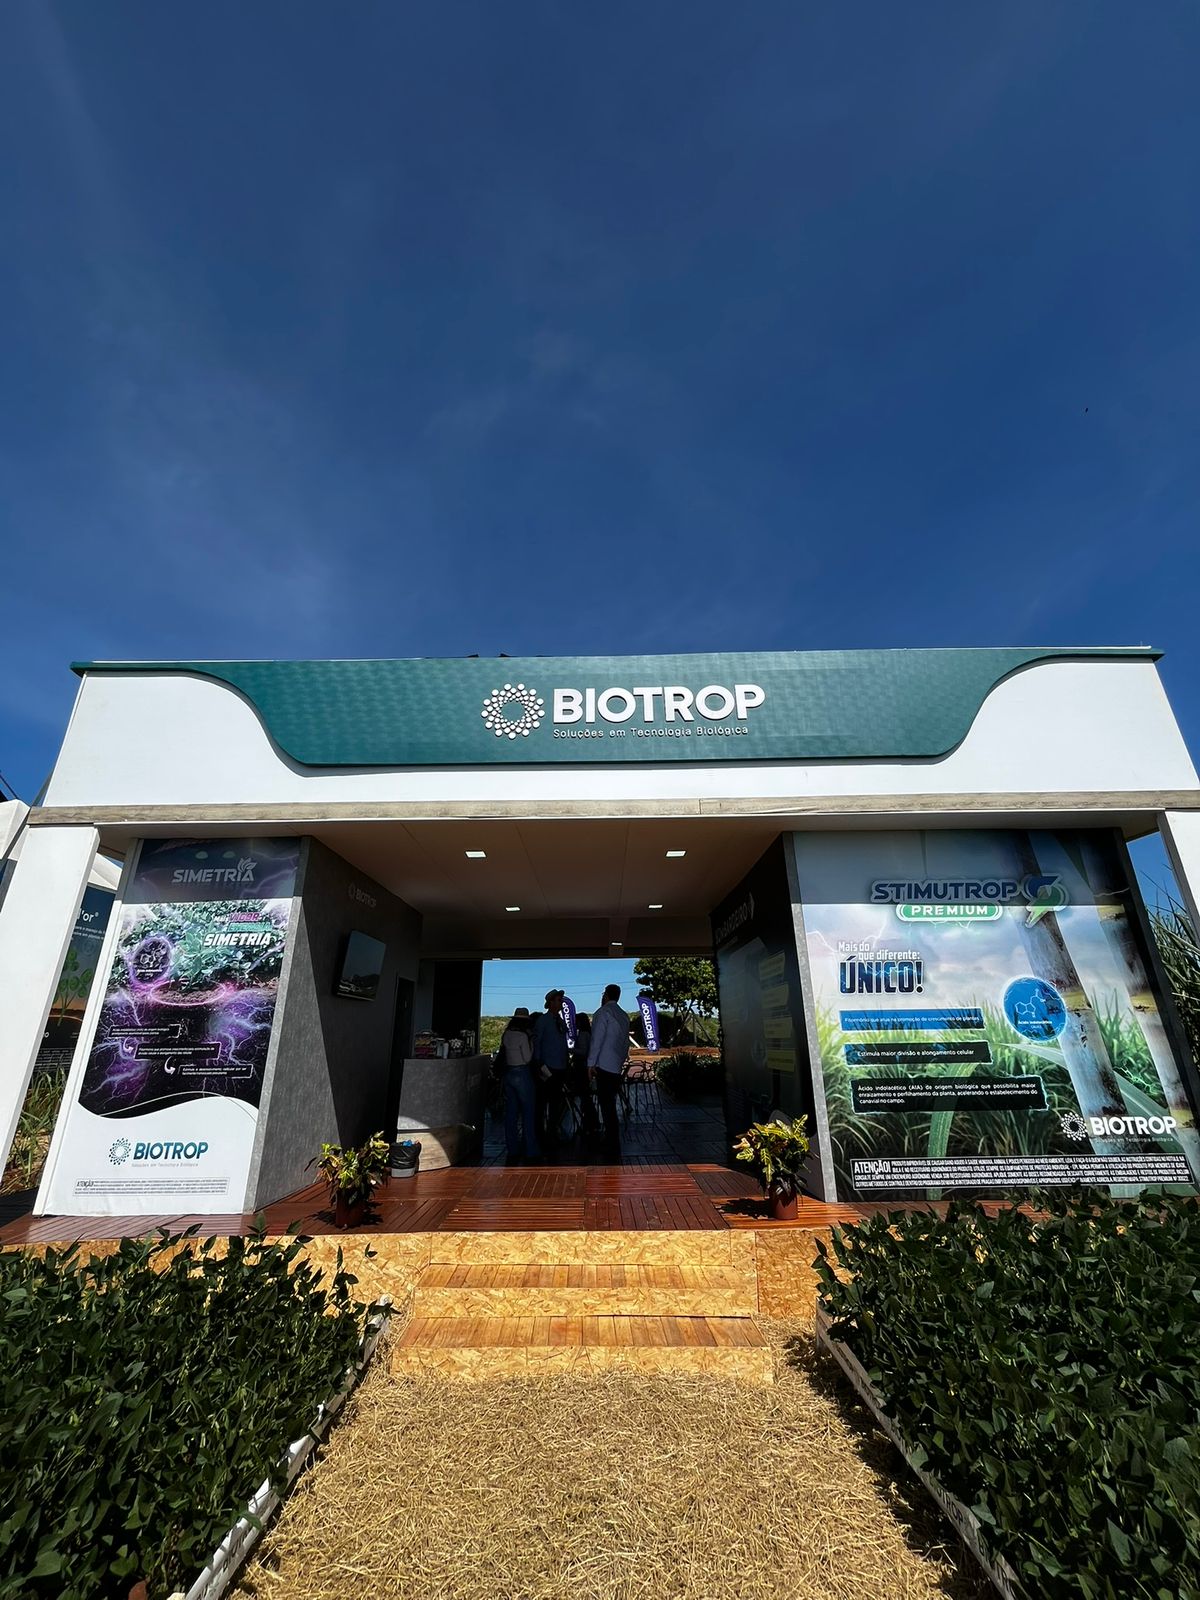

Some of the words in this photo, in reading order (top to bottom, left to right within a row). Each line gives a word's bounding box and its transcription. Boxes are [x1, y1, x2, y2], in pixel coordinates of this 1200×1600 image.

[553, 684, 766, 724] BIOTROP
[553, 729, 604, 740] Soluções
[609, 730, 626, 738] em
[631, 727, 692, 738] Tecnologia
[697, 726, 749, 736] Biológica
[172, 868, 255, 883] SIMETRIA
[873, 881, 1019, 900] STIMUTROP
[911, 904, 988, 916] PREMIUM
[203, 932, 271, 946] SIMETRIA
[838, 941, 858, 952] Mais
[859, 942, 870, 952] do
[858, 952, 874, 962] que
[876, 950, 921, 960] diferente:
[839, 955, 923, 994] ÚNICO!
[641, 1002, 654, 1039] BIOTROP
[1090, 1116, 1176, 1136] BIOTROP
[133, 1142, 208, 1160] BIOTROP
[854, 1160, 892, 1174] ATENÇÃO!
